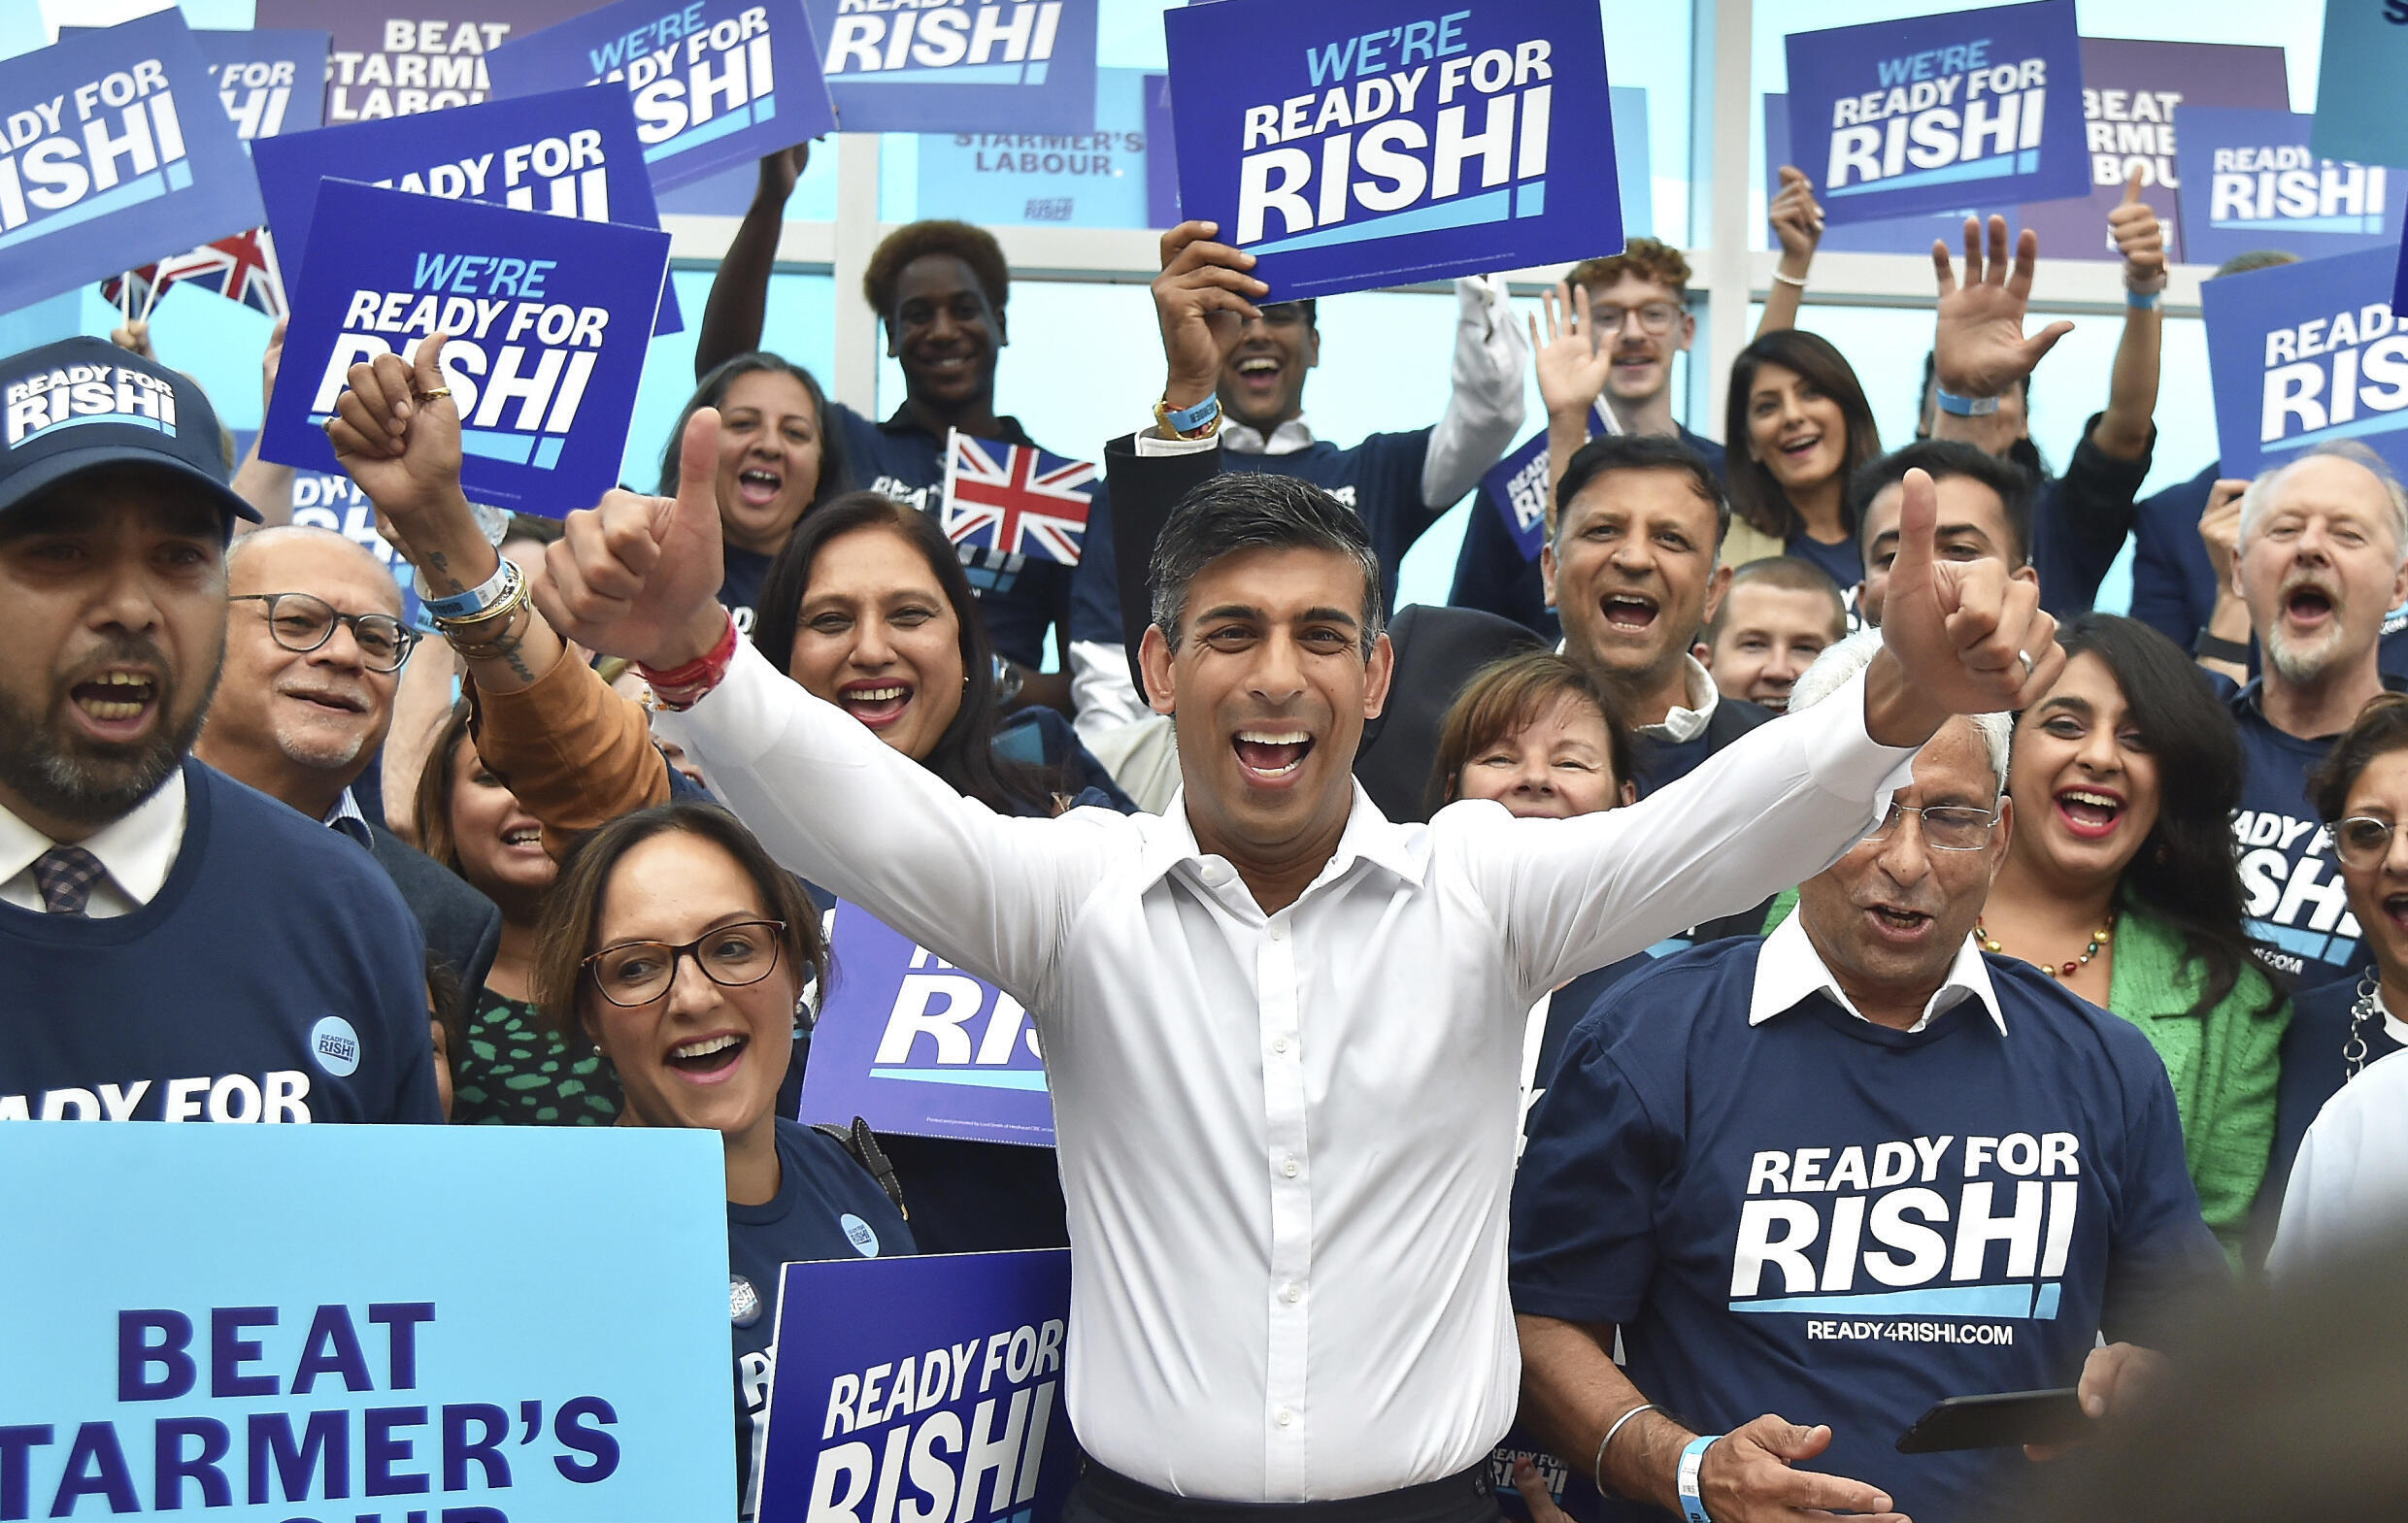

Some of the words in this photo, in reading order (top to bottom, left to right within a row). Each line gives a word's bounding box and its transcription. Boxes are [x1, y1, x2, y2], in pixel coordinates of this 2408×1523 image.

[385, 18, 511, 55] BEAT
[589, 0, 707, 76] WE'RE
[687, 6, 769, 65] FOR
[824, 2, 1063, 74] RISHI
[1307, 11, 1472, 87] WE'RE
[1877, 38, 1993, 89] WE'RE
[74, 58, 170, 122] FOR
[219, 60, 297, 90] FOR
[324, 51, 491, 90] TARM
[633, 33, 774, 144] SHI
[1243, 66, 1429, 151] READY
[1438, 39, 1553, 105] FOR
[1832, 73, 1963, 130] READY
[1965, 57, 2048, 102] FOR
[2082, 87, 2184, 123] BEAT
[0, 89, 186, 231] ISHI
[372, 153, 494, 200] ADY
[504, 129, 606, 188] FOR
[1236, 84, 1552, 246] RISHI
[1825, 86, 2048, 190] RISHI
[2211, 166, 2387, 222] RISHI
[412, 252, 557, 299] WE'RE
[343, 289, 510, 340] READY
[506, 303, 610, 348] FOR
[2264, 303, 2408, 368] READ
[7, 381, 177, 445] RISHI
[8, 364, 114, 405] READY
[116, 366, 175, 399] FOR
[311, 333, 599, 434] RSHI
[2260, 335, 2408, 444] RIS
[2227, 809, 2314, 850] ADY
[318, 1040, 355, 1058] RISHI
[320, 1033, 344, 1043] READY
[0, 1079, 151, 1121] ADY
[165, 1070, 312, 1124] FOR
[1747, 1136, 1954, 1195] READY
[1964, 1132, 2081, 1177] FOR
[1729, 1181, 2079, 1297] RISHI
[117, 1302, 436, 1403] BEAT
[1807, 1320, 2014, 1345] READY4RISHI.COM
[822, 1338, 981, 1440] READY
[978, 1318, 1065, 1395] FOR
[0, 1396, 620, 1521] TARMER'S
[804, 1379, 1056, 1523] RISHI
